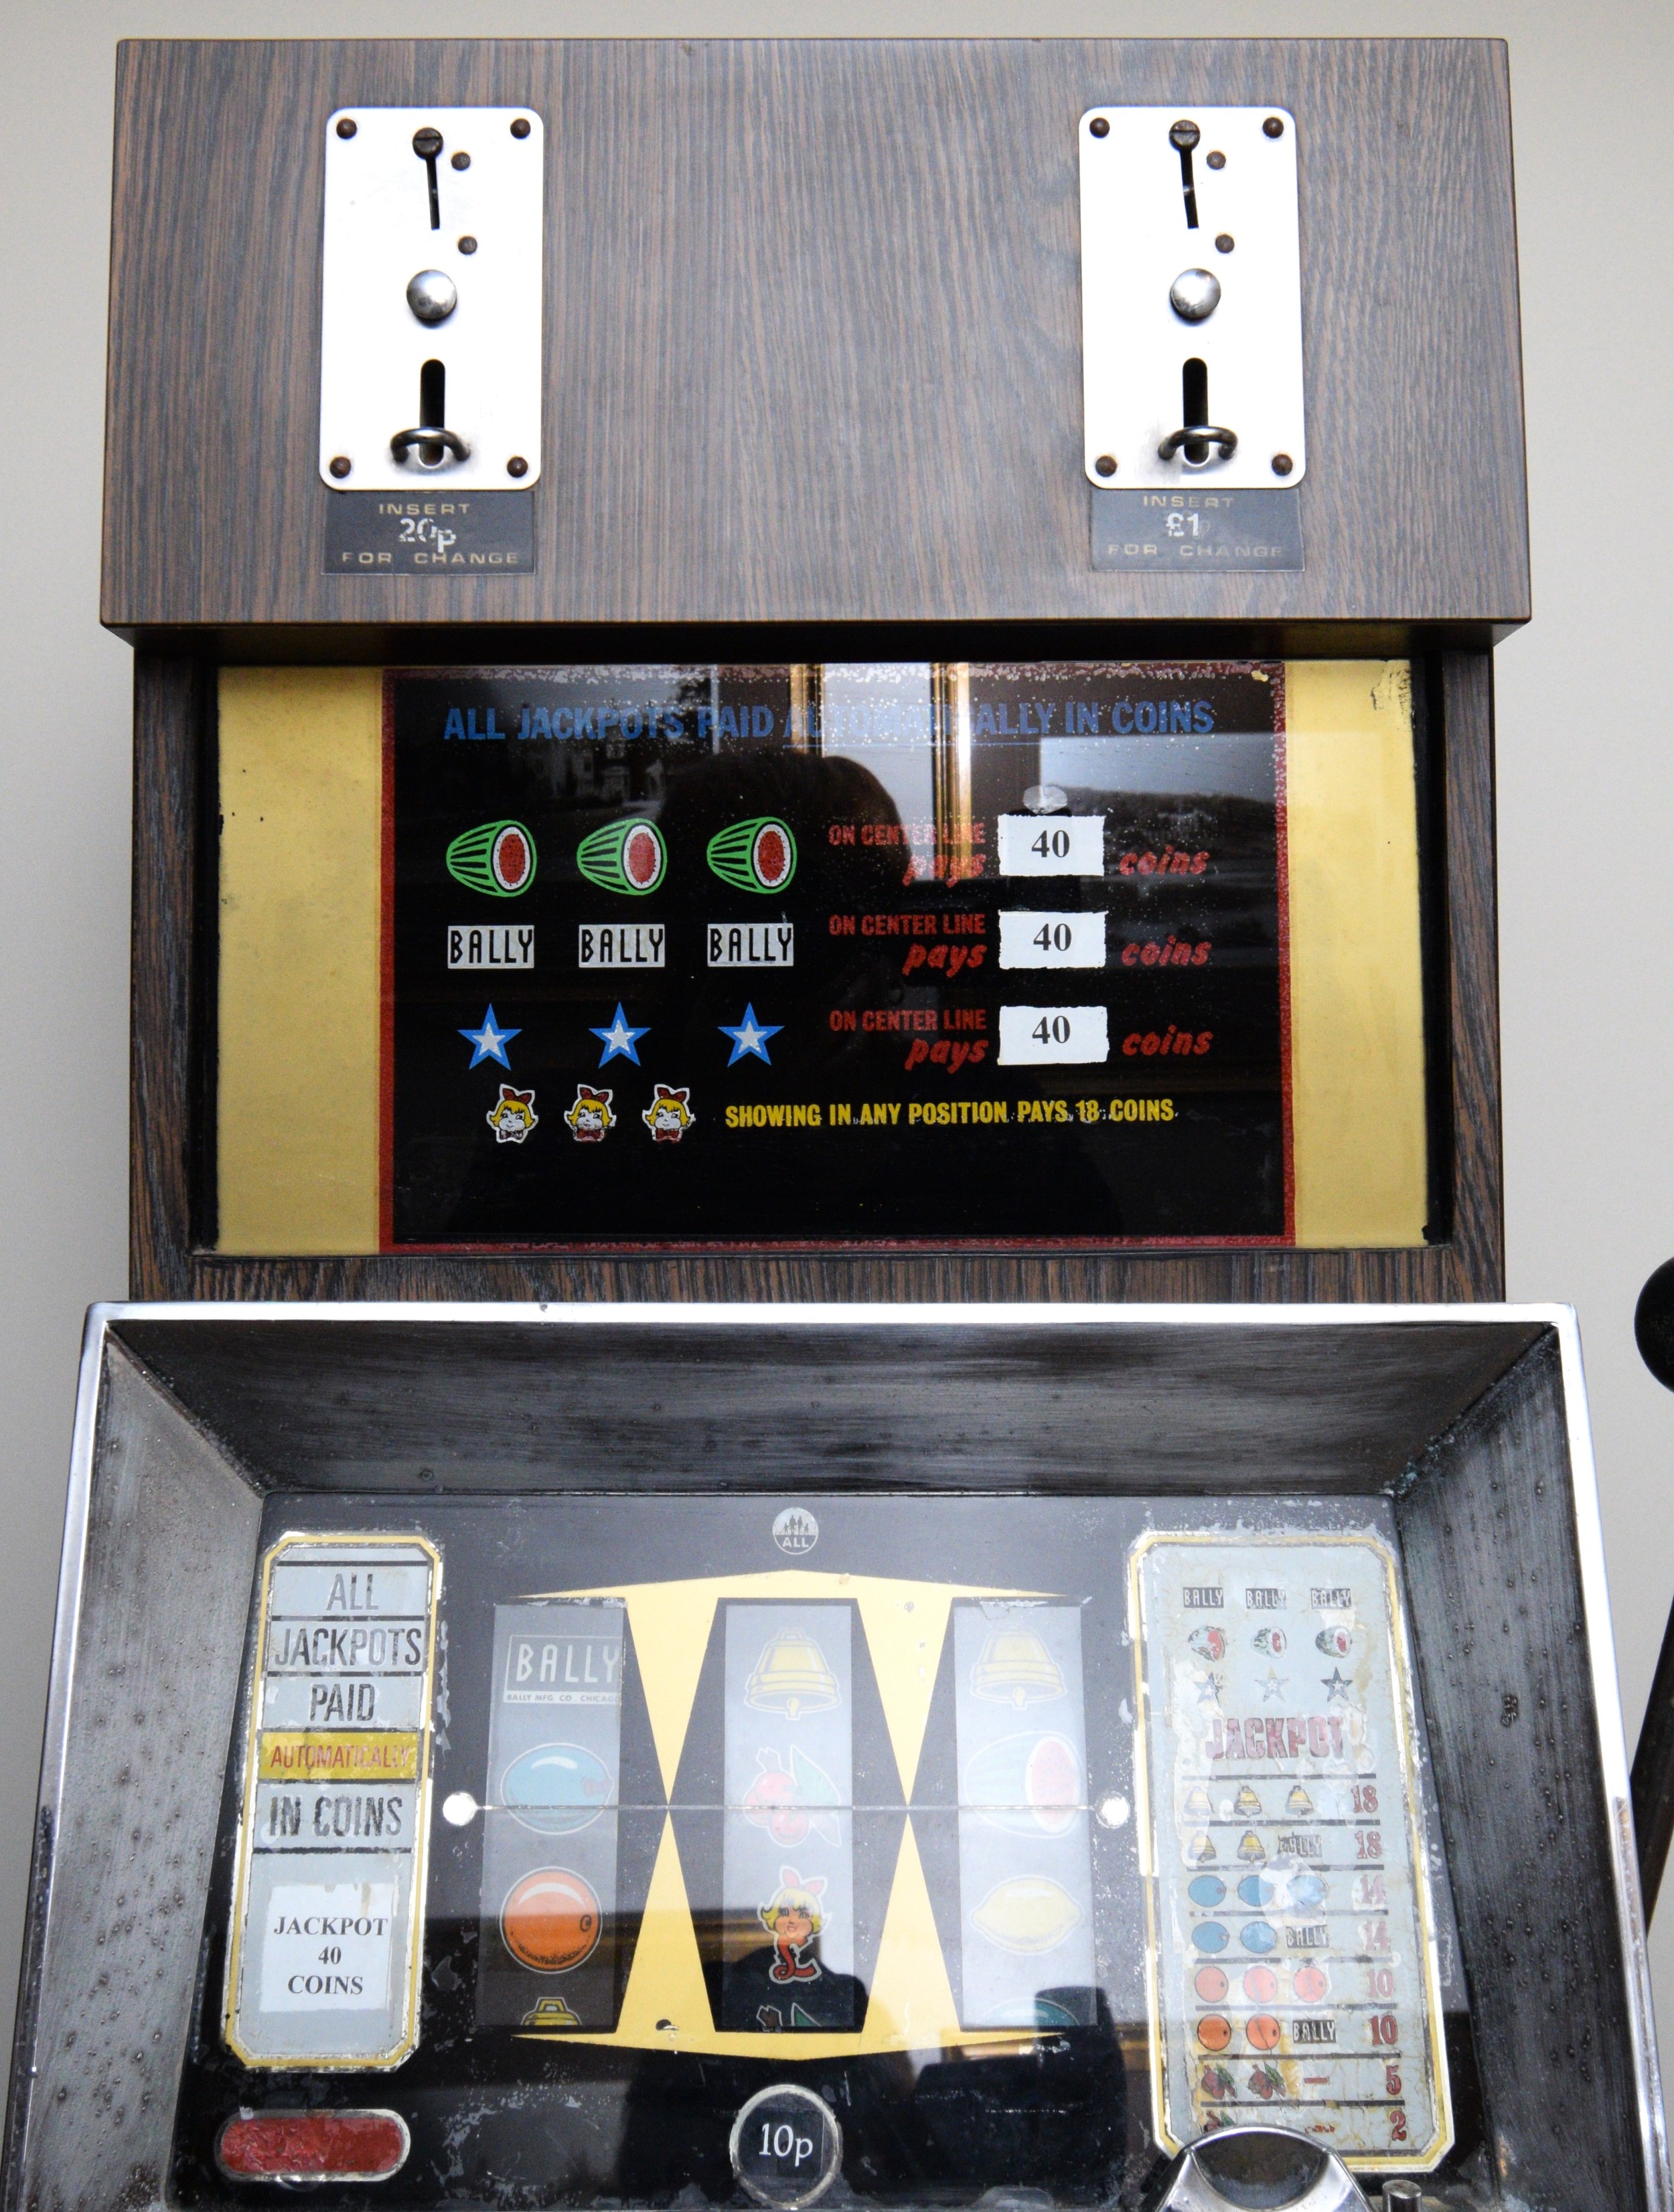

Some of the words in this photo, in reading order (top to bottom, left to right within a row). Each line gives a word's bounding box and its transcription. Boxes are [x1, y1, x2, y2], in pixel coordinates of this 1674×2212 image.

[378, 503, 471, 516] INSERT
[1143, 495, 1234, 508] INSERT
[398, 518, 457, 554] 20p
[1165, 512, 1200, 537] £1
[341, 552, 393, 564] FOR
[414, 552, 518, 564] CHANGE
[1108, 544, 1158, 556] FOR
[1179, 545, 1284, 558] CHANGE
[443, 708, 506, 740] ALL
[516, 707, 683, 740] JACKPOTS
[697, 706, 774, 740] PAID
[783, 703, 1055, 738] AUTOMATIALLY
[1065, 702, 1099, 734] IN
[1112, 700, 1215, 734] COINS
[829, 823, 854, 846] ON
[861, 823, 937, 845] CENTER
[943, 823, 986, 844] LINE
[901, 853, 986, 888] pays
[1031, 830, 1070, 858] 40
[1119, 845, 1209, 876] coins
[830, 914, 855, 936] ON
[862, 914, 937, 935] CENTER
[944, 913, 987, 934] LINE
[450, 930, 532, 964] BALLY
[581, 929, 664, 963] BALLY
[710, 928, 792, 962] BALLY
[902, 943, 987, 978] pays
[1033, 923, 1072, 951] 40
[1120, 936, 1212, 966] coins
[830, 1010, 856, 1032] ON
[862, 1010, 938, 1031] CENTER
[945, 1009, 988, 1030] LINE
[905, 1039, 988, 1073] pays
[1032, 1016, 1071, 1044] 40
[1122, 1026, 1213, 1056] coins
[726, 1104, 821, 1127] SHOWING
[830, 1104, 851, 1125] IN
[860, 1103, 901, 1125] ANY
[909, 1101, 1006, 1125] POSITION
[1018, 1101, 1067, 1123] PAYS
[1075, 1100, 1098, 1121] 18
[1112, 1099, 1174, 1121] COINS
[783, 1536, 809, 1548] ALL
[326, 1573, 378, 1611] ALL
[1184, 1589, 1224, 1607] BALLY
[1247, 1591, 1287, 1607] BALLY
[1312, 1589, 1351, 1608] BALLY
[275, 1628, 422, 1666] JACKPOTS
[516, 1644, 621, 1684] BALLY
[310, 1683, 376, 1723] PAID
[1207, 1717, 1343, 1759] JACKPOT
[271, 1745, 409, 1769] AUTOMATICALLY
[1351, 1784, 1378, 1813] 18
[269, 1796, 301, 1837] IN
[315, 1796, 403, 1838] COINS
[1355, 1830, 1383, 1859] 18
[274, 1916, 388, 1936] JACKPOT
[1286, 1926, 1326, 1946] BALLY
[318, 1946, 341, 1965] 40
[288, 1975, 363, 1994] COINS
[1367, 1968, 1393, 1997] 10
[1293, 2021, 1335, 2043] BALLY
[1370, 2014, 1398, 2045] 10
[1386, 2065, 1401, 2095] 5
[1390, 2110, 1407, 2141] 2
[759, 2123, 813, 2166] 10p
